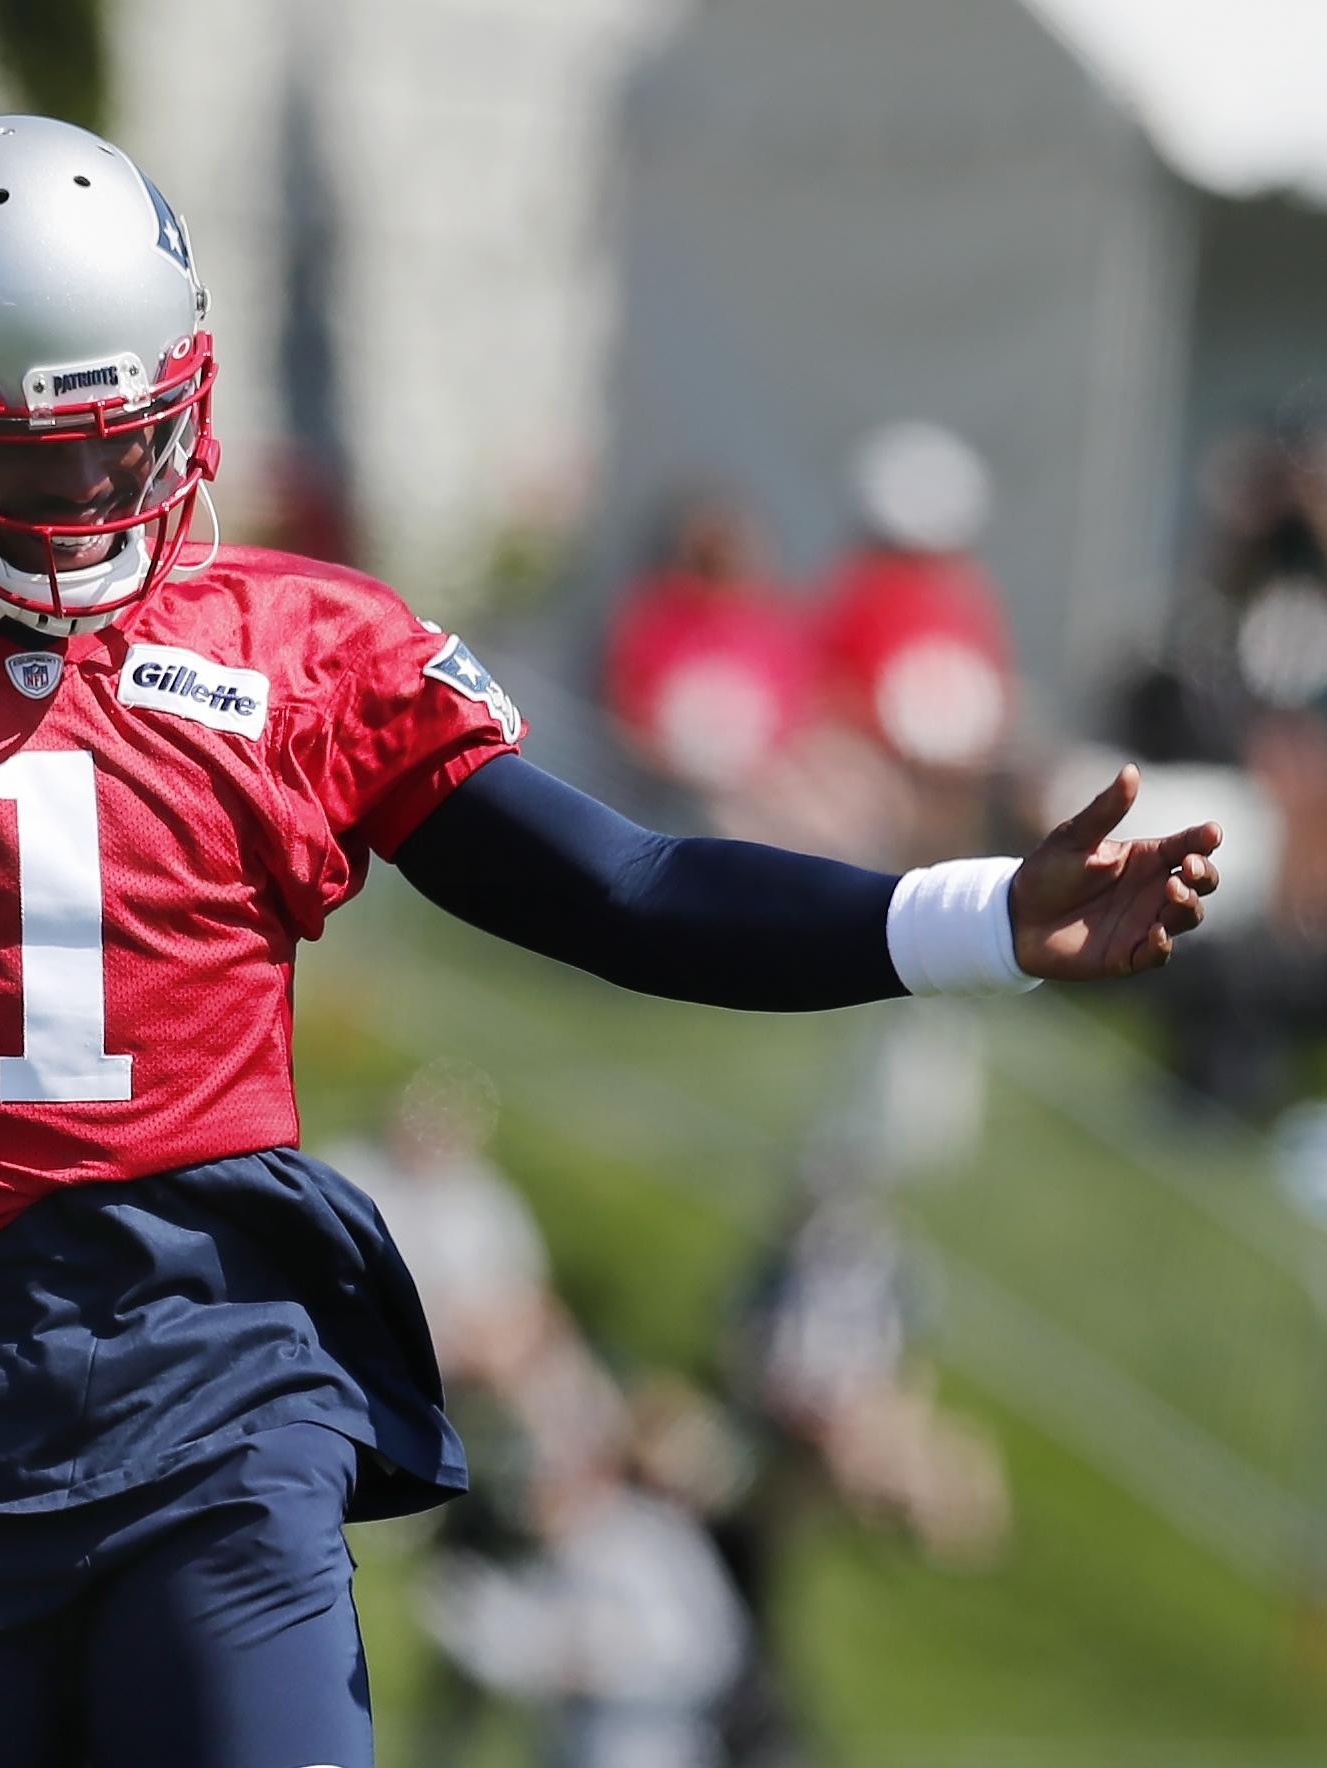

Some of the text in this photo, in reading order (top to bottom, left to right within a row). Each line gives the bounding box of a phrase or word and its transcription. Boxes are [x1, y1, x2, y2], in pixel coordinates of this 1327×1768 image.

[53, 366, 118, 396] PATRIOTS
[27, 674, 48, 687] NFL
[132, 662, 256, 716] Gillette
